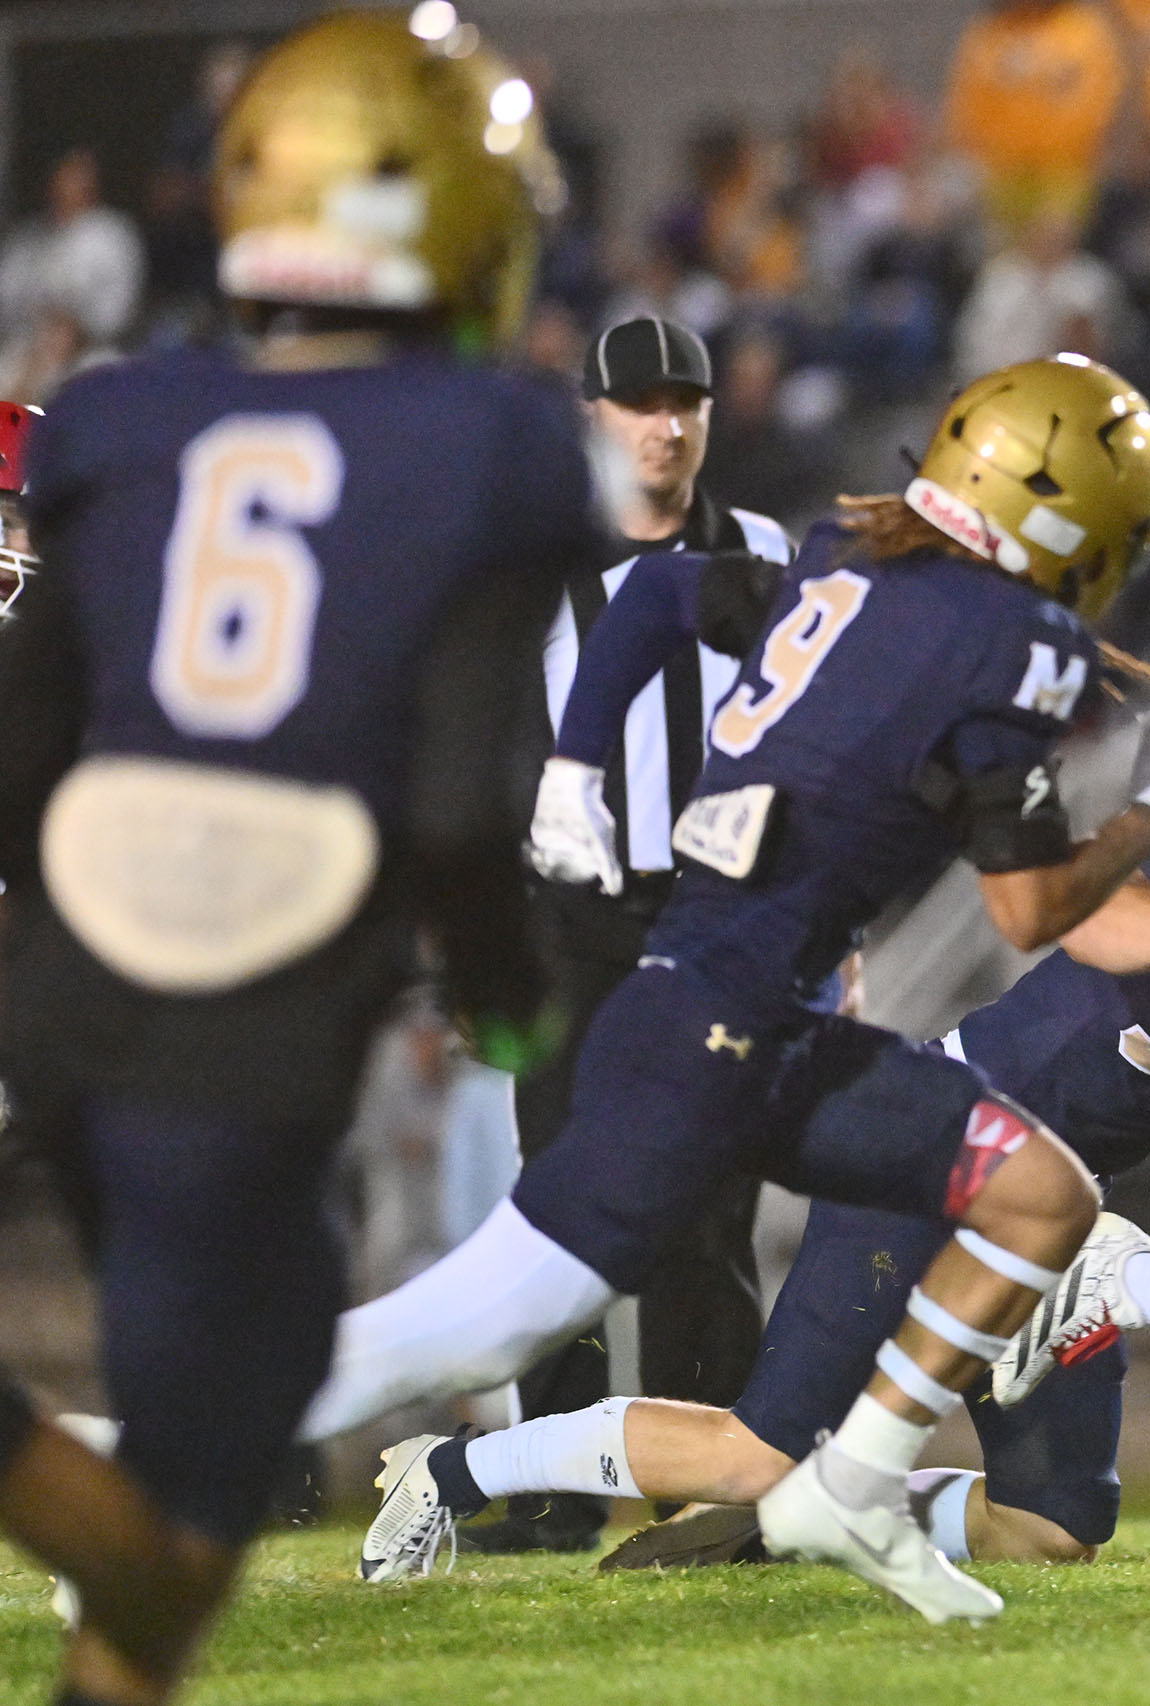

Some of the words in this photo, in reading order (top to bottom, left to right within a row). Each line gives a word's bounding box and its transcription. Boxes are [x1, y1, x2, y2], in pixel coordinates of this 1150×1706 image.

[150, 411, 346, 741] 6
[711, 568, 872, 760] 9
[1013, 641, 1088, 721] M
